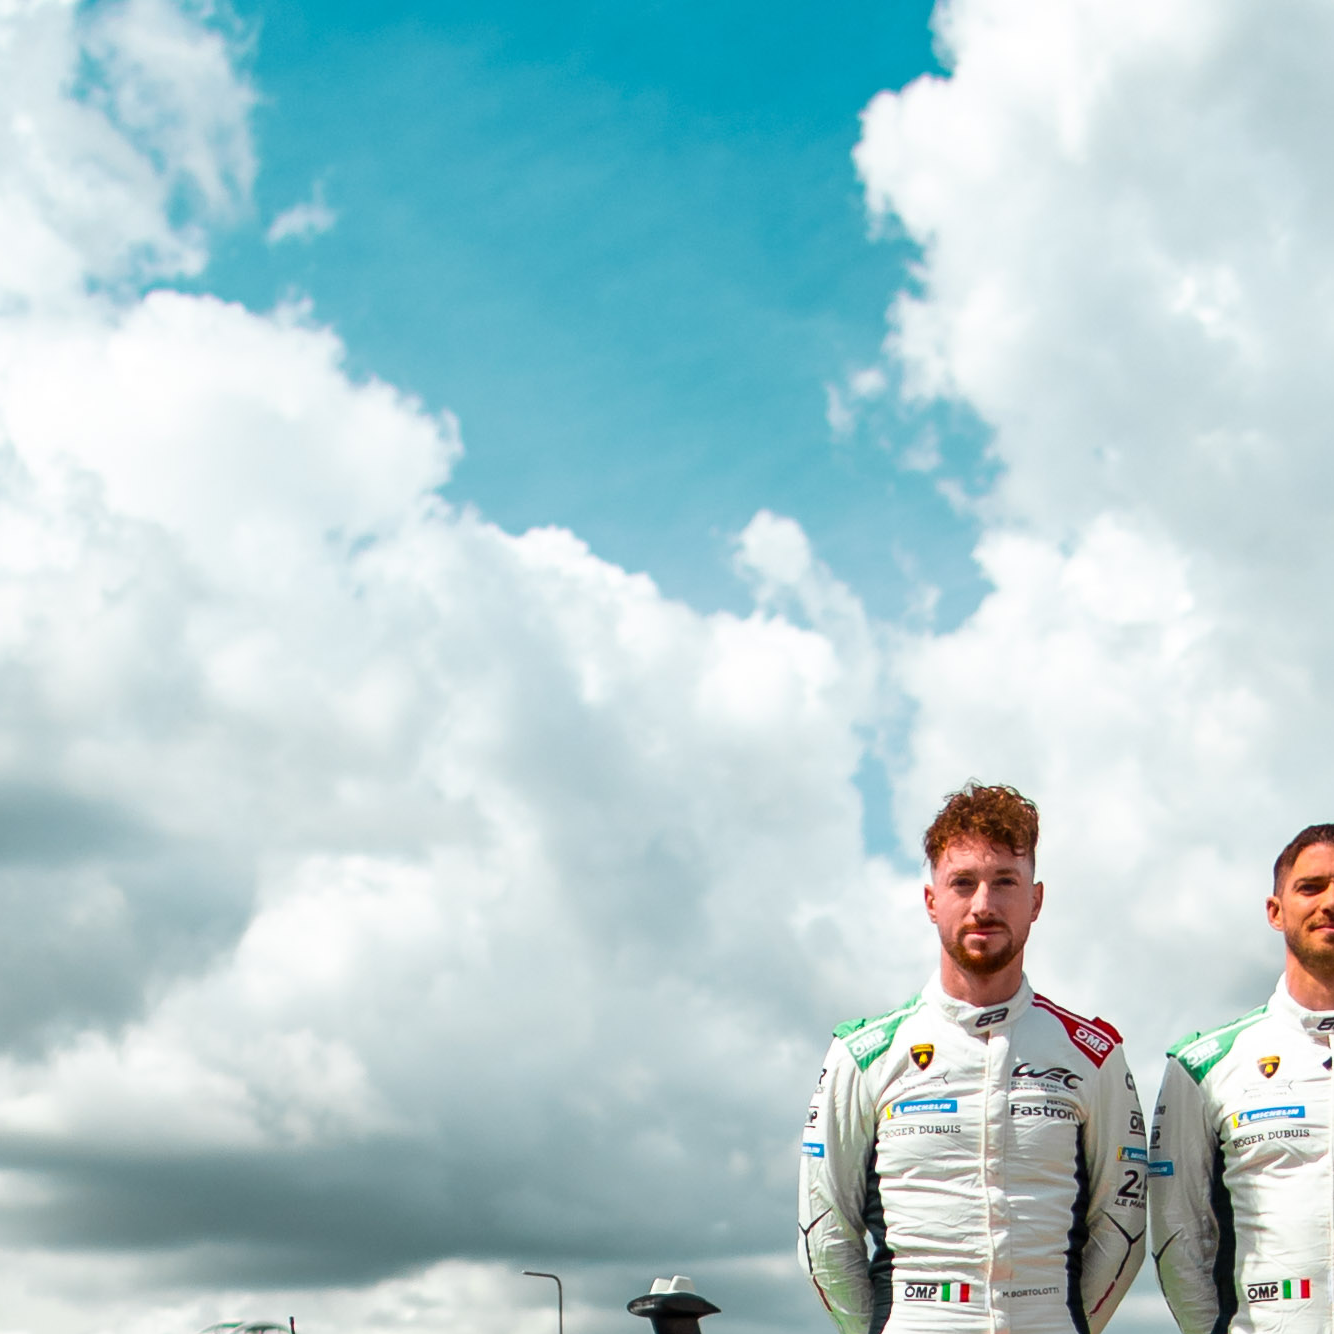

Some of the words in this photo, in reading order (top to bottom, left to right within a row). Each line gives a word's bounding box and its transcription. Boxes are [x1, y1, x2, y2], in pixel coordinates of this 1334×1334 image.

[975, 1007, 1009, 1028] 63
[1075, 1028, 1109, 1052] OMP
[1011, 1062, 1084, 1090] WEC
[1010, 1104, 1075, 1121] Fastron
[1250, 1108, 1300, 1120] MICHELIN
[919, 1124, 962, 1134] DUBUIS
[1233, 1134, 1265, 1150] ROGER
[1268, 1129, 1310, 1140] DUBUIS
[904, 1285, 938, 1299] OMP
[1247, 1284, 1279, 1300] OMP
